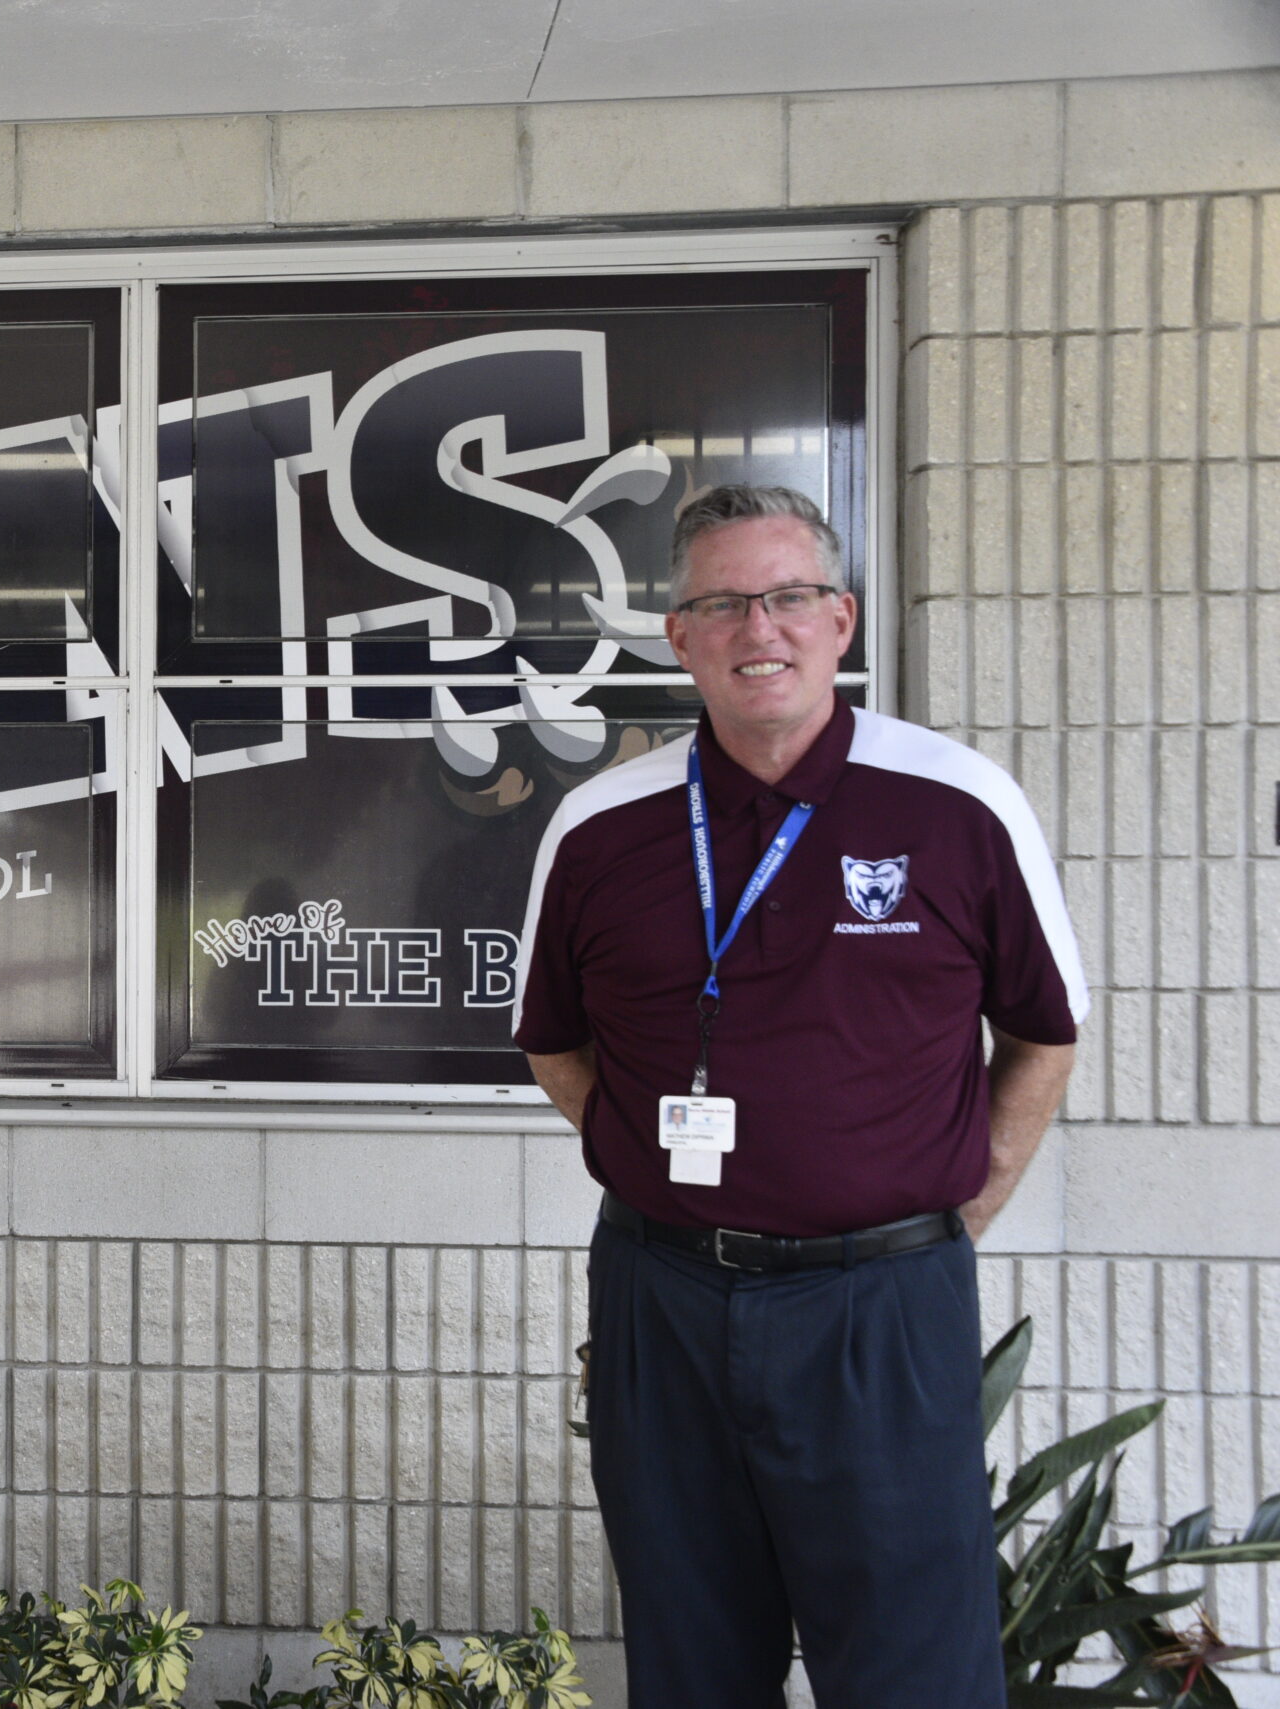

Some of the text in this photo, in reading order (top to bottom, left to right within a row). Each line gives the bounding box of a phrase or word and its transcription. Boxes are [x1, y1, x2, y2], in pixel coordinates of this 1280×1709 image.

[689, 782, 713, 909] HILLSBOROUGH STRONG
[194, 913, 297, 968] Home
[833, 921, 920, 935] ADMINISTRATION
[244, 928, 522, 1008] THE B
